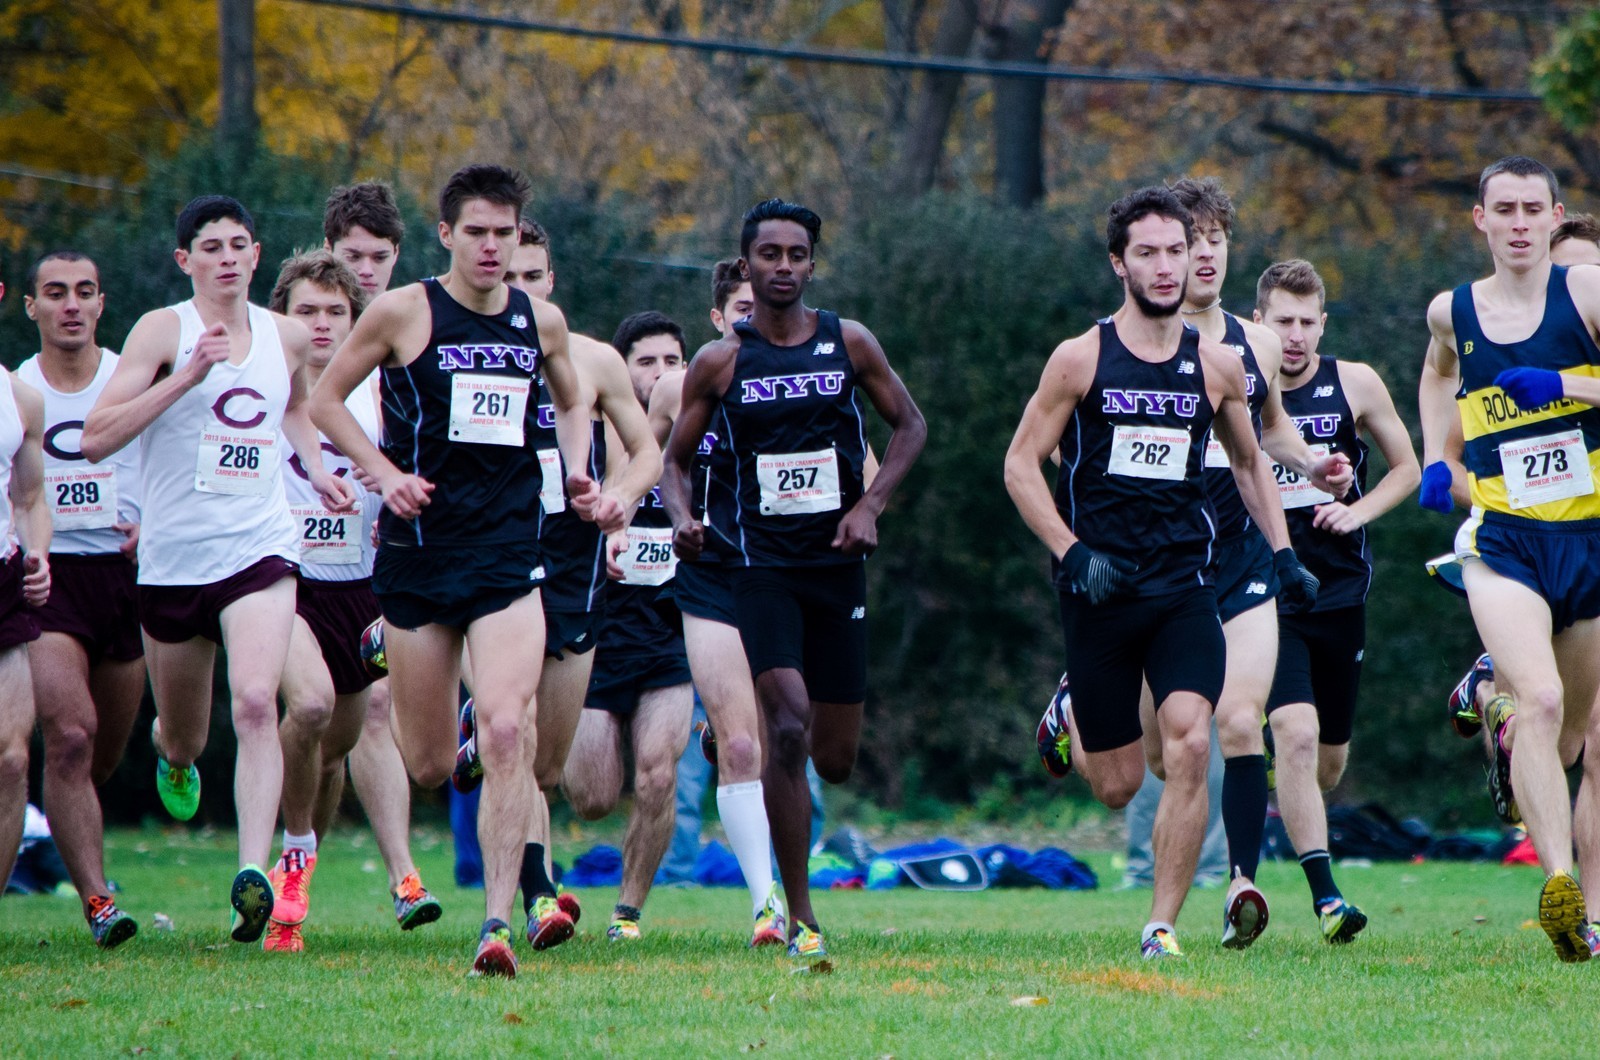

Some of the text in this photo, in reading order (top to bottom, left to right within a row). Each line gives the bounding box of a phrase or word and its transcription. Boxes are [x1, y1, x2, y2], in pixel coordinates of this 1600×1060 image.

[437, 344, 537, 372] NYU
[741, 371, 845, 404] NYU
[211, 387, 267, 429] C
[472, 391, 510, 418] 261
[1102, 388, 1199, 418] NYU
[203, 433, 219, 442] 2013
[218, 443, 260, 470] 286
[1130, 441, 1171, 466] 262
[1503, 448, 1519, 457] 2013
[1522, 448, 1569, 480] 273
[777, 466, 819, 492] 257
[1272, 464, 1300, 485] 25
[1524, 473, 1573, 488] CARNEGIE MELLON
[56, 481, 100, 506] 289
[303, 518, 346, 540] 284
[635, 542, 672, 563] 258
